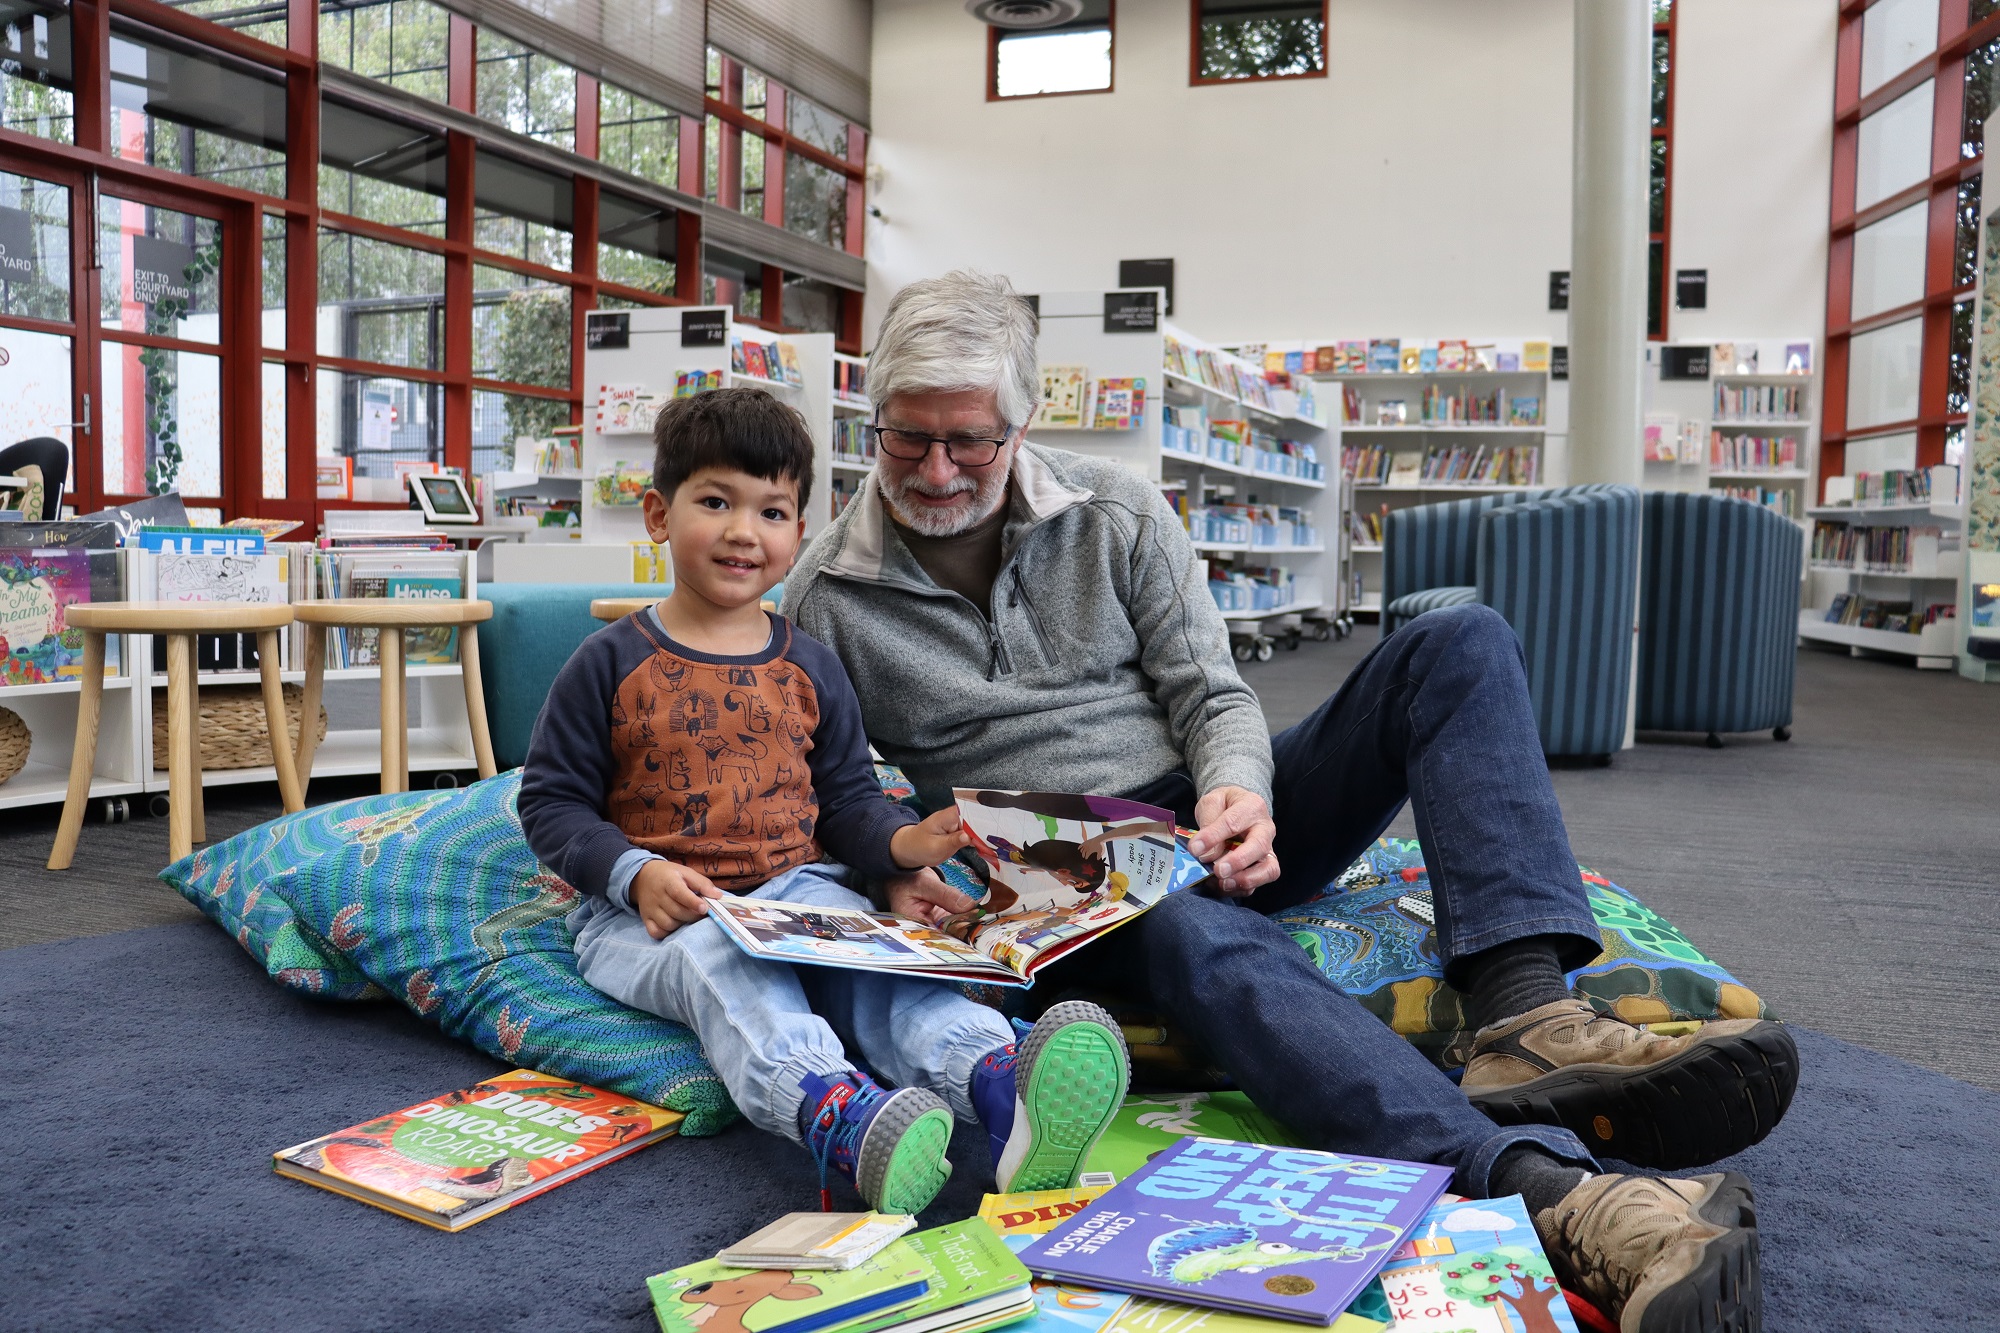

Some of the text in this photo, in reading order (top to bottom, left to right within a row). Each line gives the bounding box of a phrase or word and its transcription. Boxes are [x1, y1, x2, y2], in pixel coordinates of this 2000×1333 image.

[135, 269, 169, 284] EXIT TO
[135, 281, 190, 298] COURTYARD
[135, 291, 159, 303] ONLY
[1687, 365, 1708, 374] DVD
[45, 531, 69, 544] How
[0, 603, 51, 624] reams
[10, 587, 41, 609] My
[1146, 848, 1156, 886] prepared.
[1158, 860, 1166, 874] She
[471, 1091, 611, 1134] DOES
[400, 1103, 587, 1163] DINOSAUR
[401, 1127, 509, 1163] ROAR?
[1136, 1142, 1266, 1199] END
[1212, 1151, 1354, 1226] DEEP
[1043, 1211, 1120, 1257] THOMSON
[1075, 1217, 1135, 1254] CHARLIE
[1290, 1195, 1400, 1248] THE
[939, 1233, 975, 1267] That's
[957, 1261, 988, 1281] not
[1425, 1301, 1458, 1318] of
